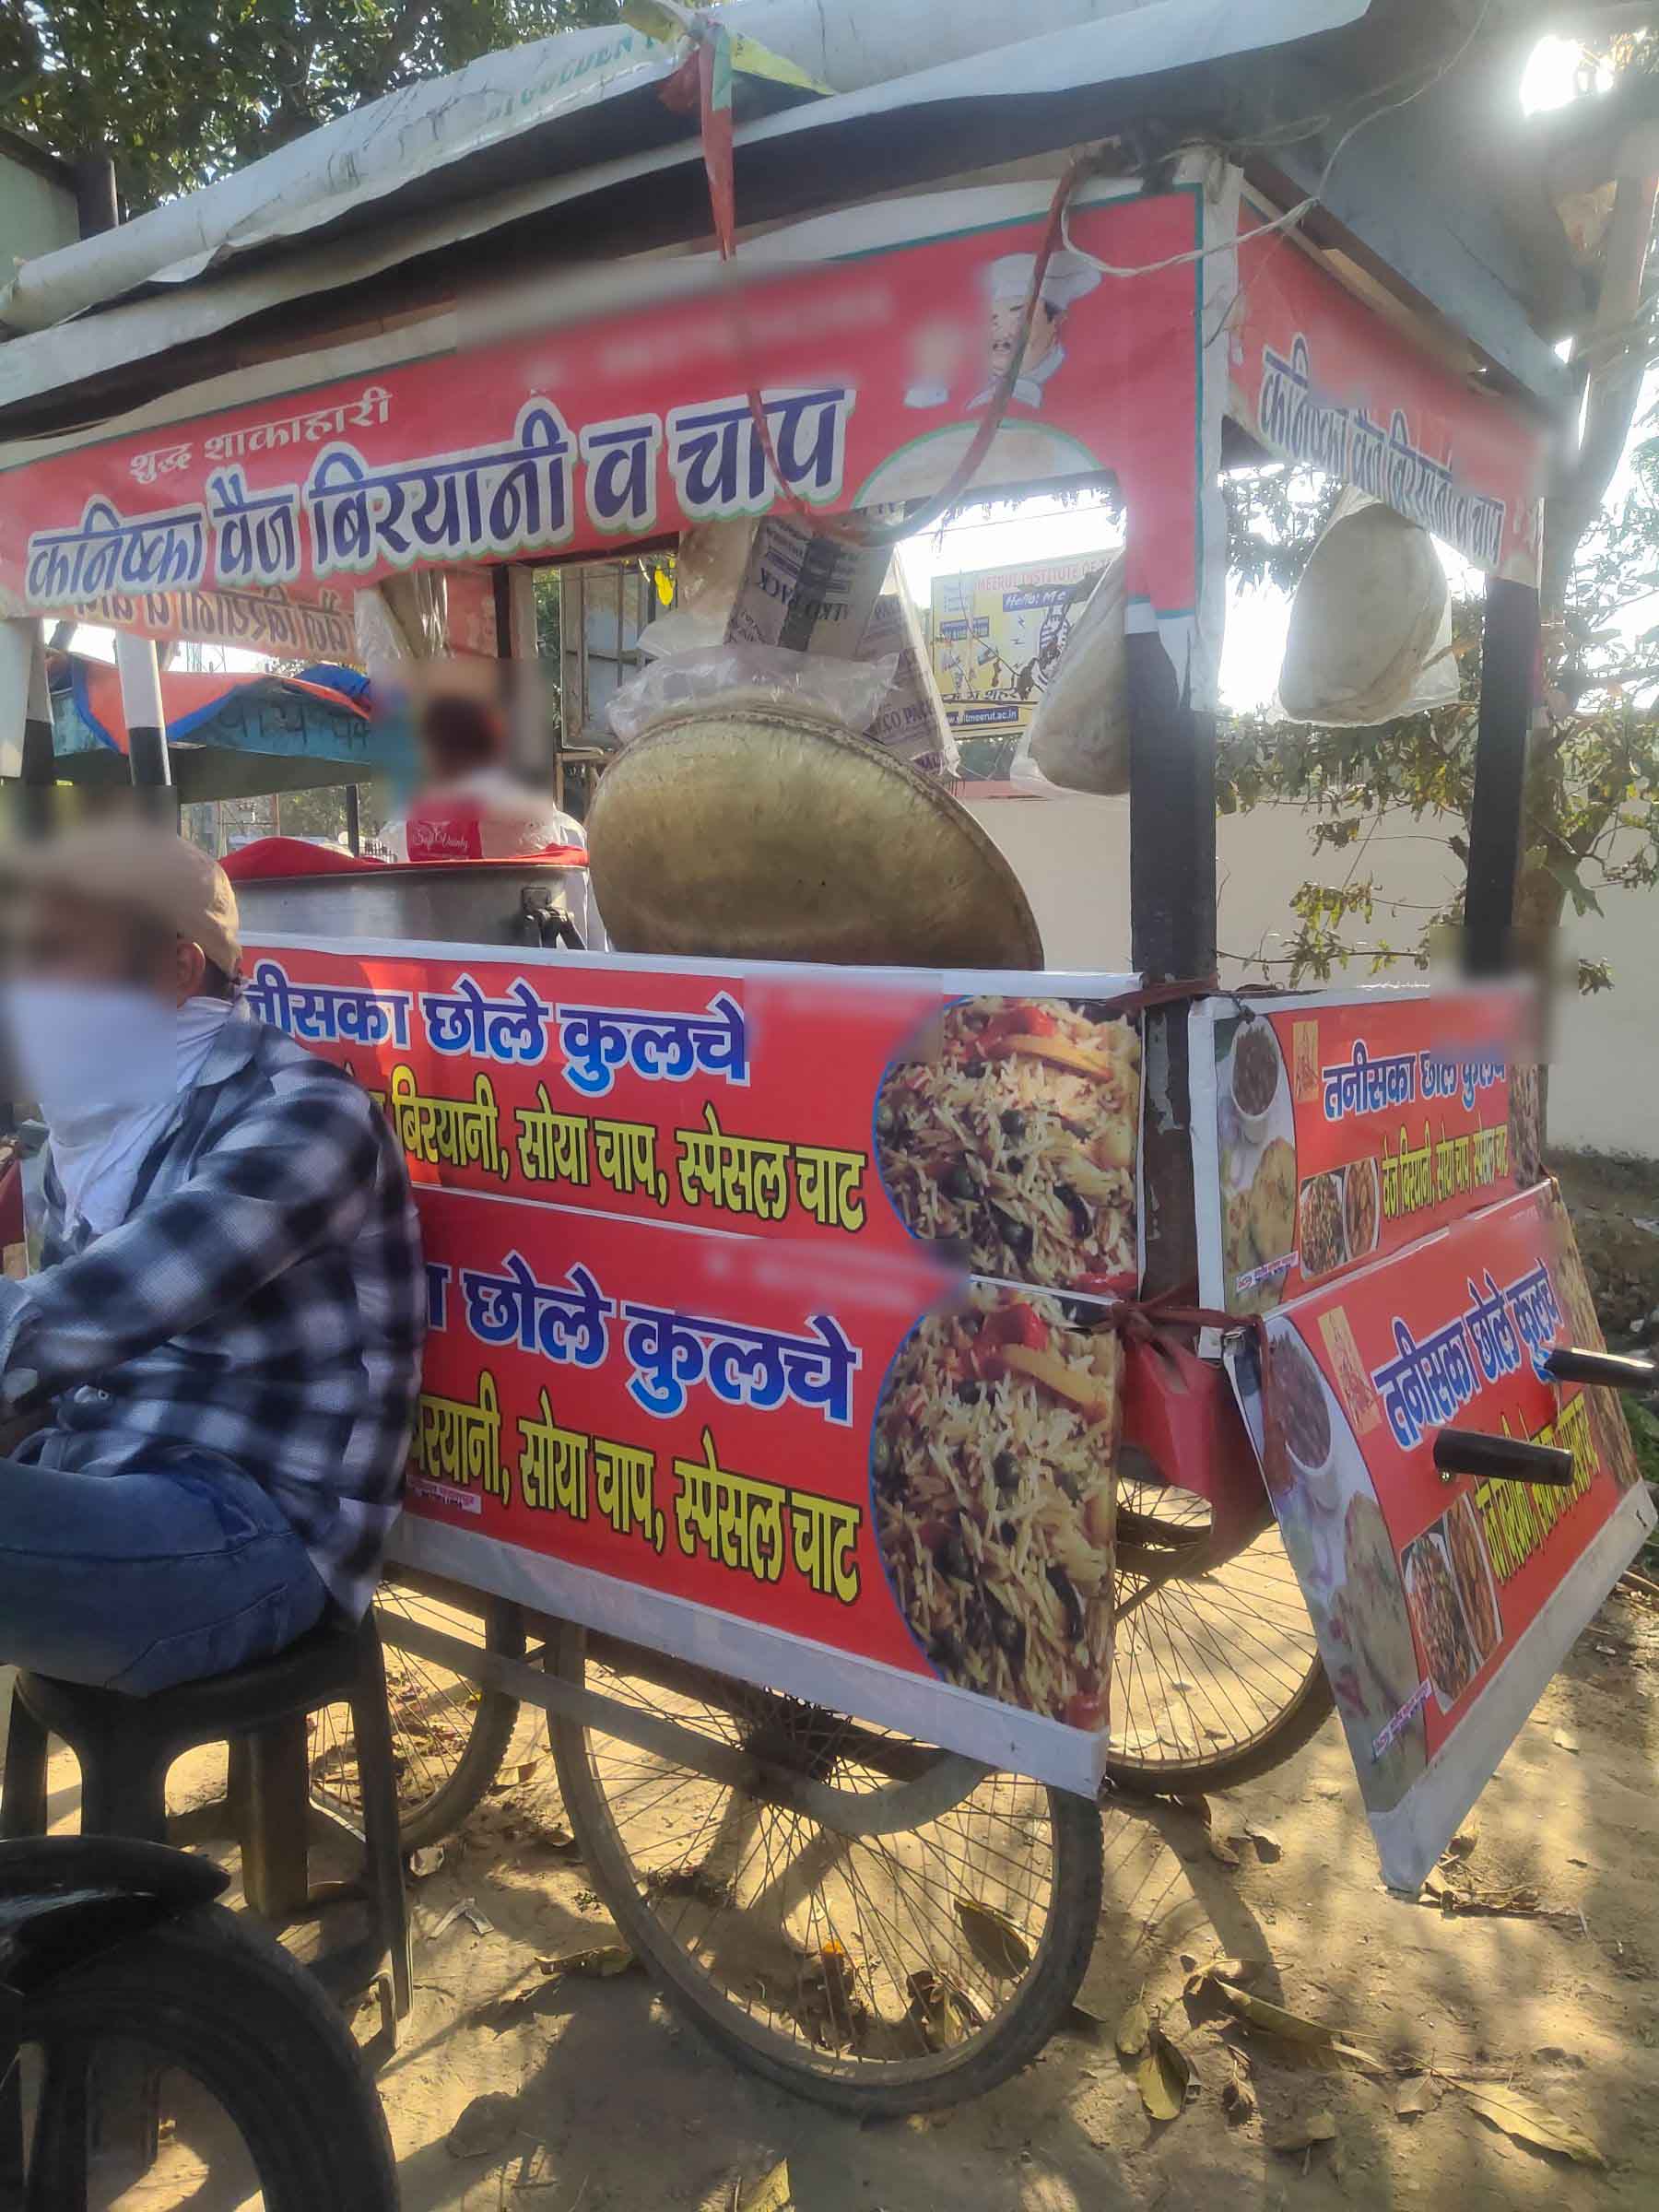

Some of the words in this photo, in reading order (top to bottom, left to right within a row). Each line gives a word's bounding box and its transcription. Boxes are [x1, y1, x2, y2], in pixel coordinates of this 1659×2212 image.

[127, 442, 194, 484] शुद्ध
[204, 385, 394, 462] शाकाहारी
[209, 472, 297, 577] वैज
[306, 408, 570, 566] बिरयानी
[588, 425, 653, 518] व
[675, 388, 846, 506] चाप
[243, 959, 413, 1049] नीसका
[418, 973, 553, 1065] छोले
[555, 992, 750, 1097] कुलचे
[1323, 1039, 1417, 1121] तनीसका
[389, 1063, 510, 1181] बिरयानी,
[514, 1080, 589, 1186] सोया
[593, 1118, 668, 1207] चाप,
[675, 1100, 791, 1221] स्पेसल
[794, 1144, 867, 1233] चाट
[459, 1249, 617, 1370] छोले
[619, 1301, 863, 1428] कुलचे
[1371, 1316, 1481, 1452] तनीसका
[517, 1387, 589, 1521] सोया
[594, 1439, 665, 1554] चाप,
[672, 1424, 787, 1583] स्पेसल
[789, 1489, 862, 1606] चाट
